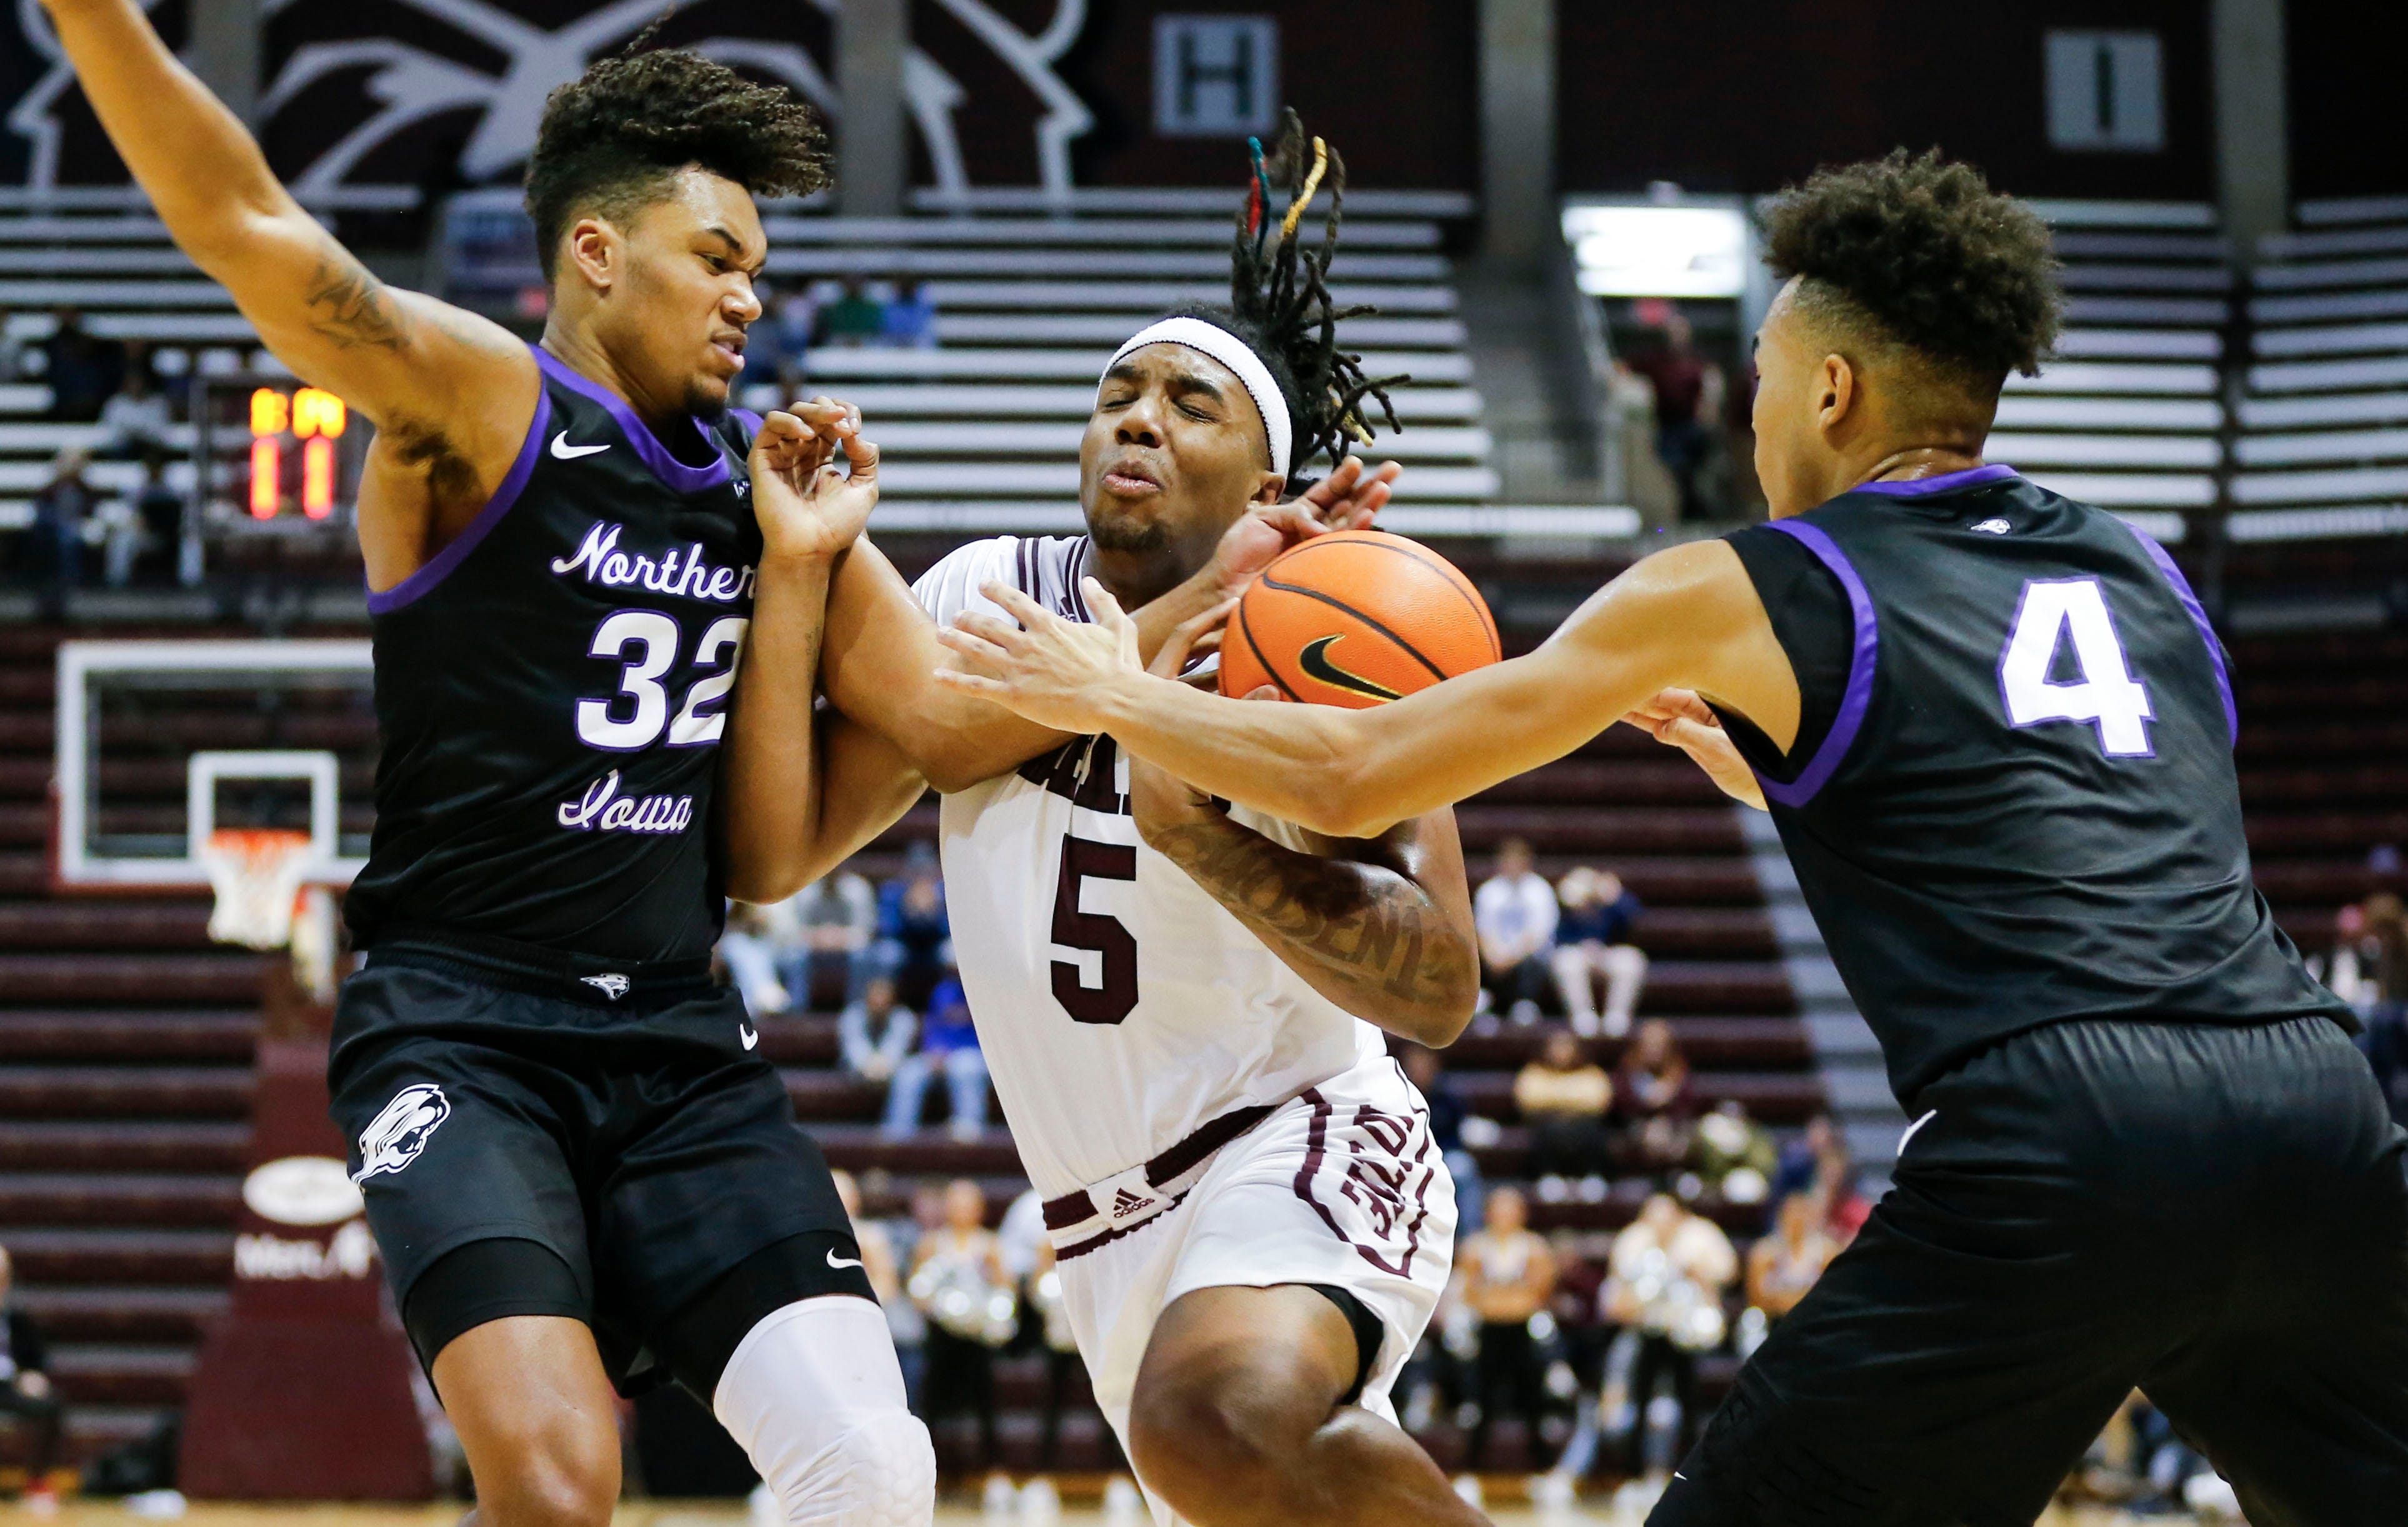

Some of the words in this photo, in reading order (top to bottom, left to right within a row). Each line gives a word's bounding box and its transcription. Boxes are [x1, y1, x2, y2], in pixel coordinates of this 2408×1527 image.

[1176, 33, 1253, 117] H
[575, 608, 749, 749] 32
[1996, 576, 2156, 759] 4
[557, 768, 692, 832] Iowa
[1051, 833, 1139, 1024] 5
[1114, 1198, 1155, 1218] adidas
